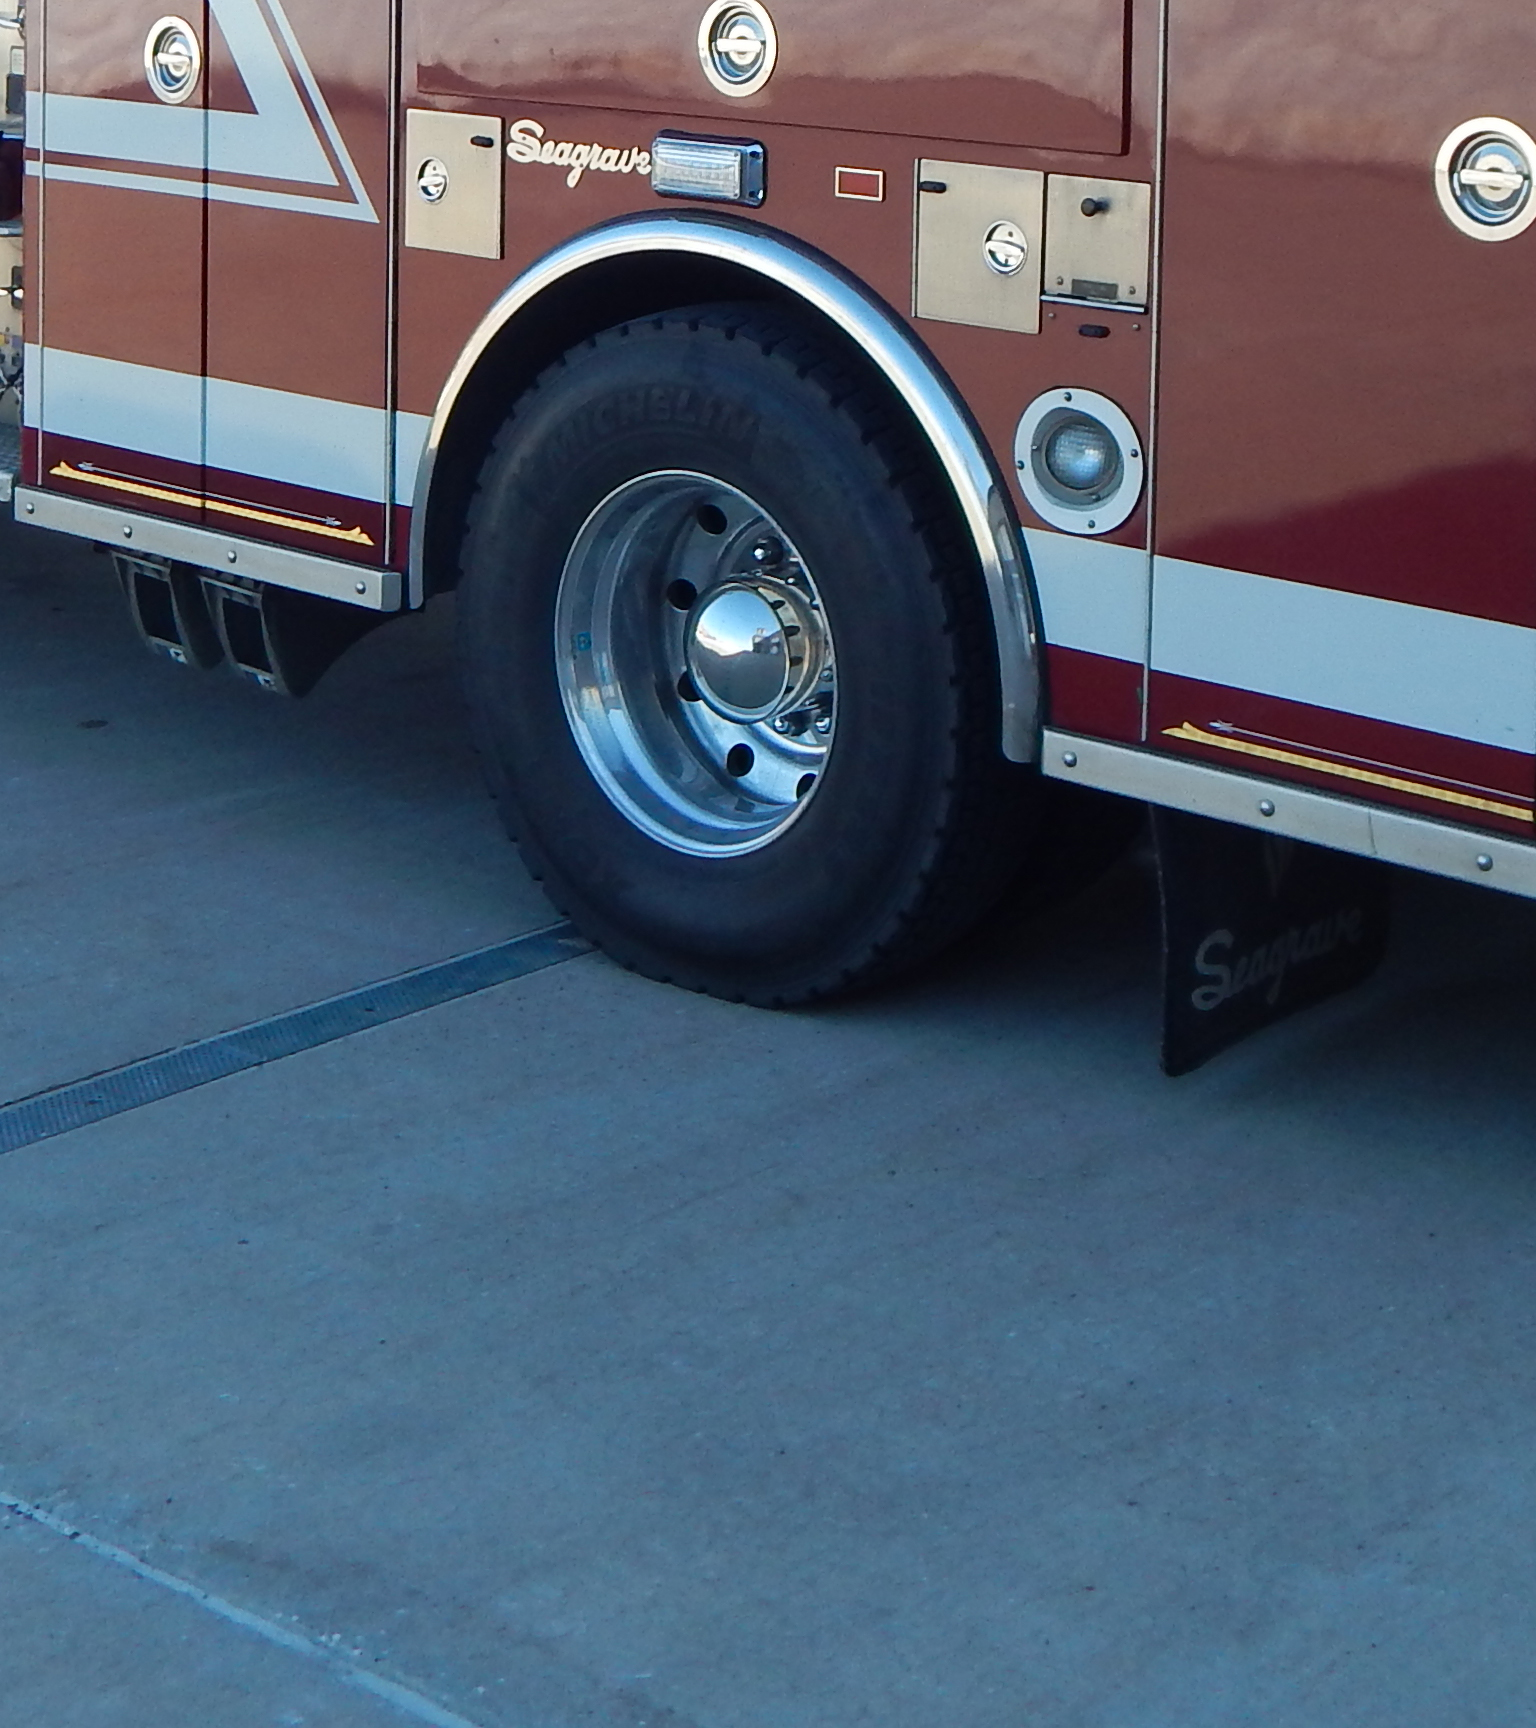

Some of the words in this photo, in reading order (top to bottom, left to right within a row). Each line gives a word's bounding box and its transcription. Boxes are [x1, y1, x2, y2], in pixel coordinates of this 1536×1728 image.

[506, 119, 652, 189] Seagrave
[548, 385, 757, 463] MICHELIN
[1190, 906, 1364, 1012] Seagrave
